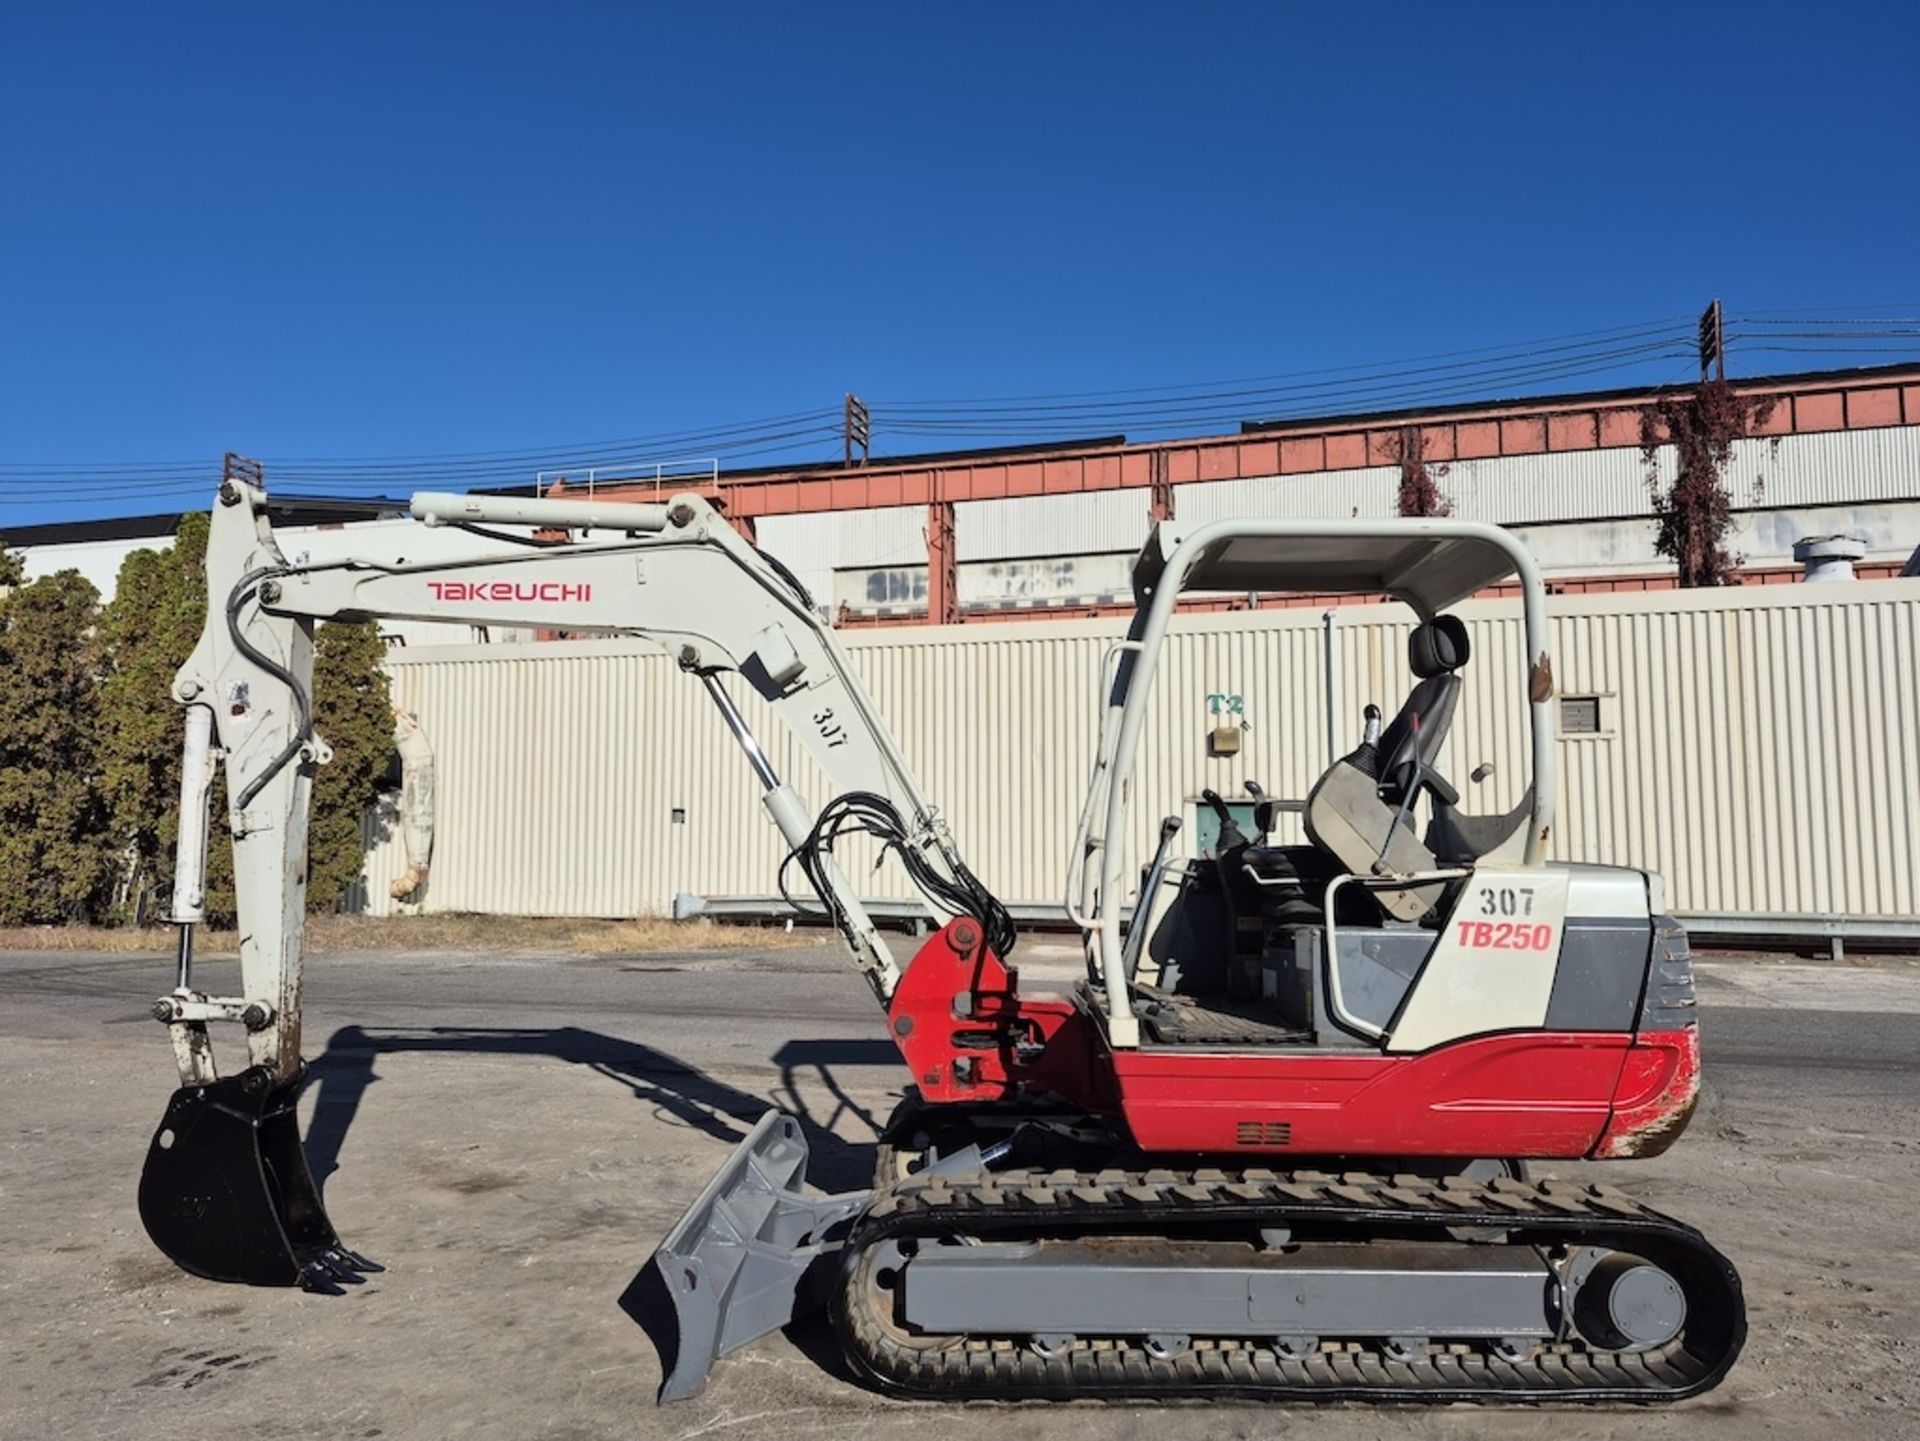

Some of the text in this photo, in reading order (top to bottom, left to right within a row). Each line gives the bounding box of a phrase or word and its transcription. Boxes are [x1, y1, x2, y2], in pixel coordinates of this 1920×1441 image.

[1207, 694, 1244, 715] T2
[1479, 888, 1535, 916] 307
[1457, 921, 1553, 951] TB250
